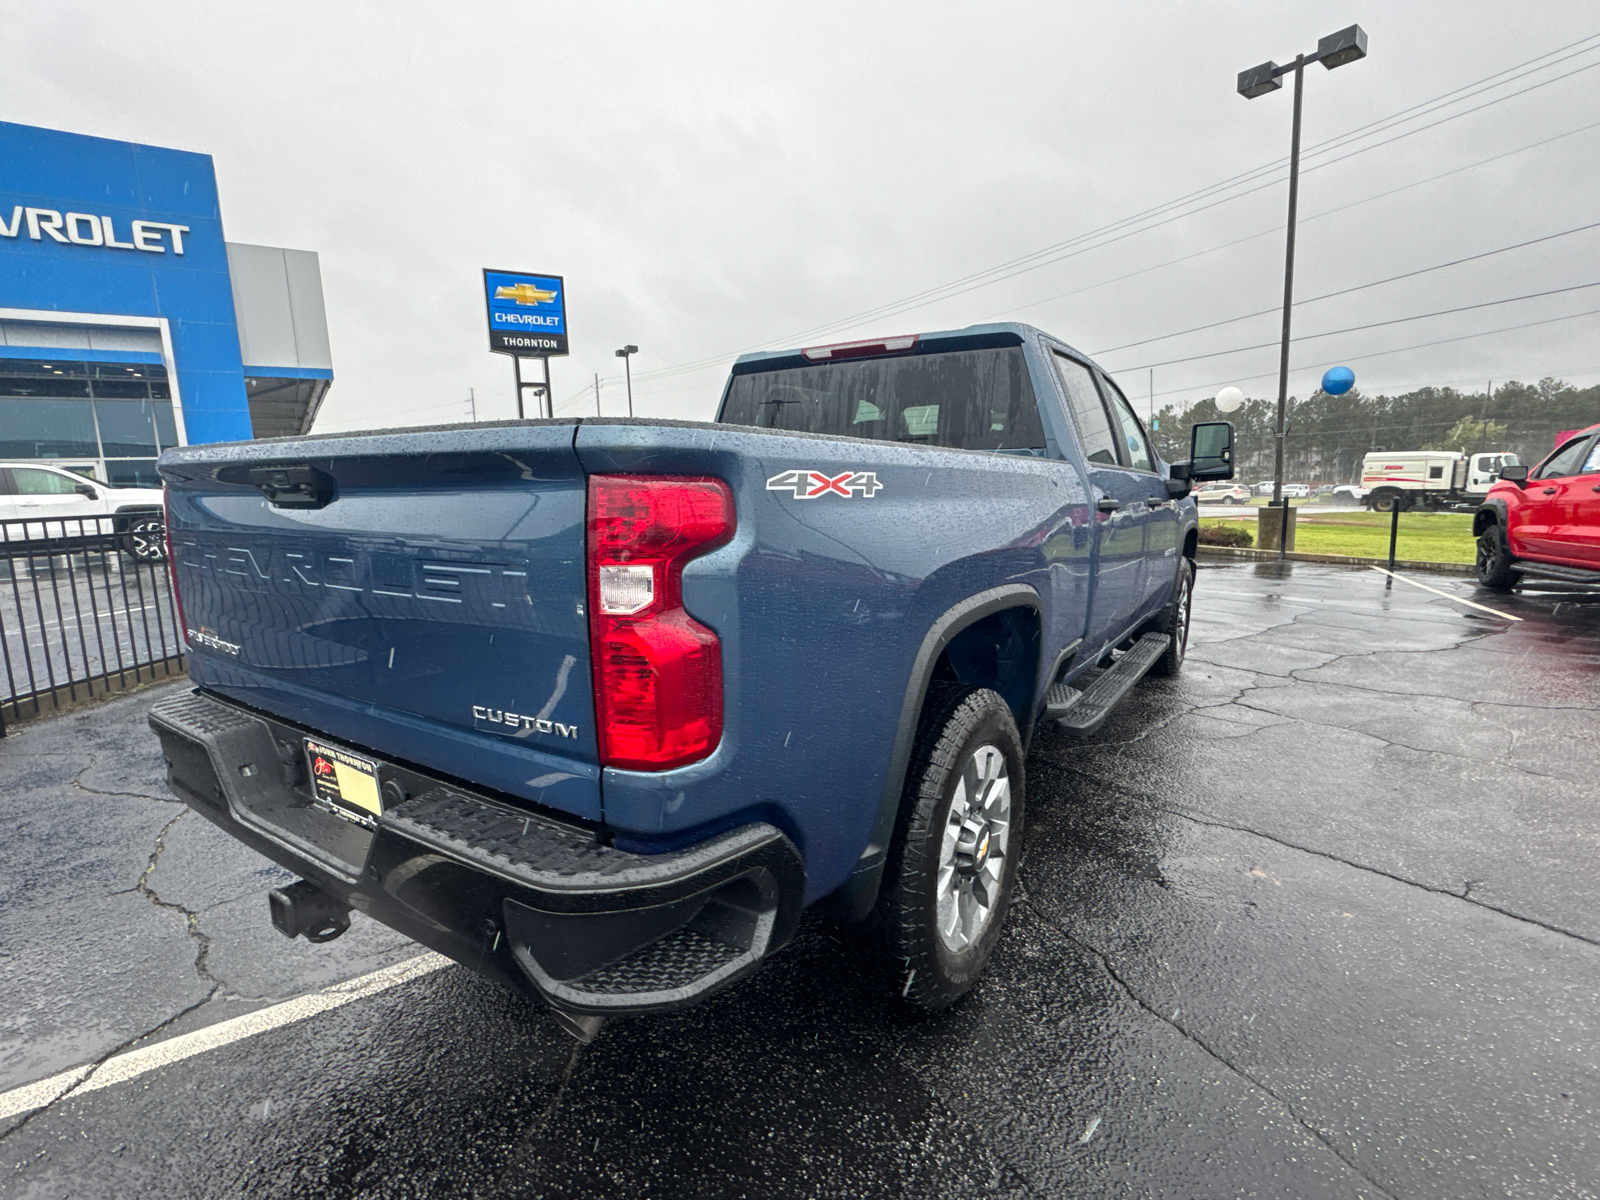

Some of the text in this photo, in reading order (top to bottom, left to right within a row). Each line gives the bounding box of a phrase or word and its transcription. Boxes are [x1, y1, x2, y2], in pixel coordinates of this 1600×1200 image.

[495, 312, 559, 326] CHEVROLET
[503, 336, 557, 348] THORNTON
[472, 705, 578, 740] CUSTOM
[319, 746, 336, 759] JOHN
